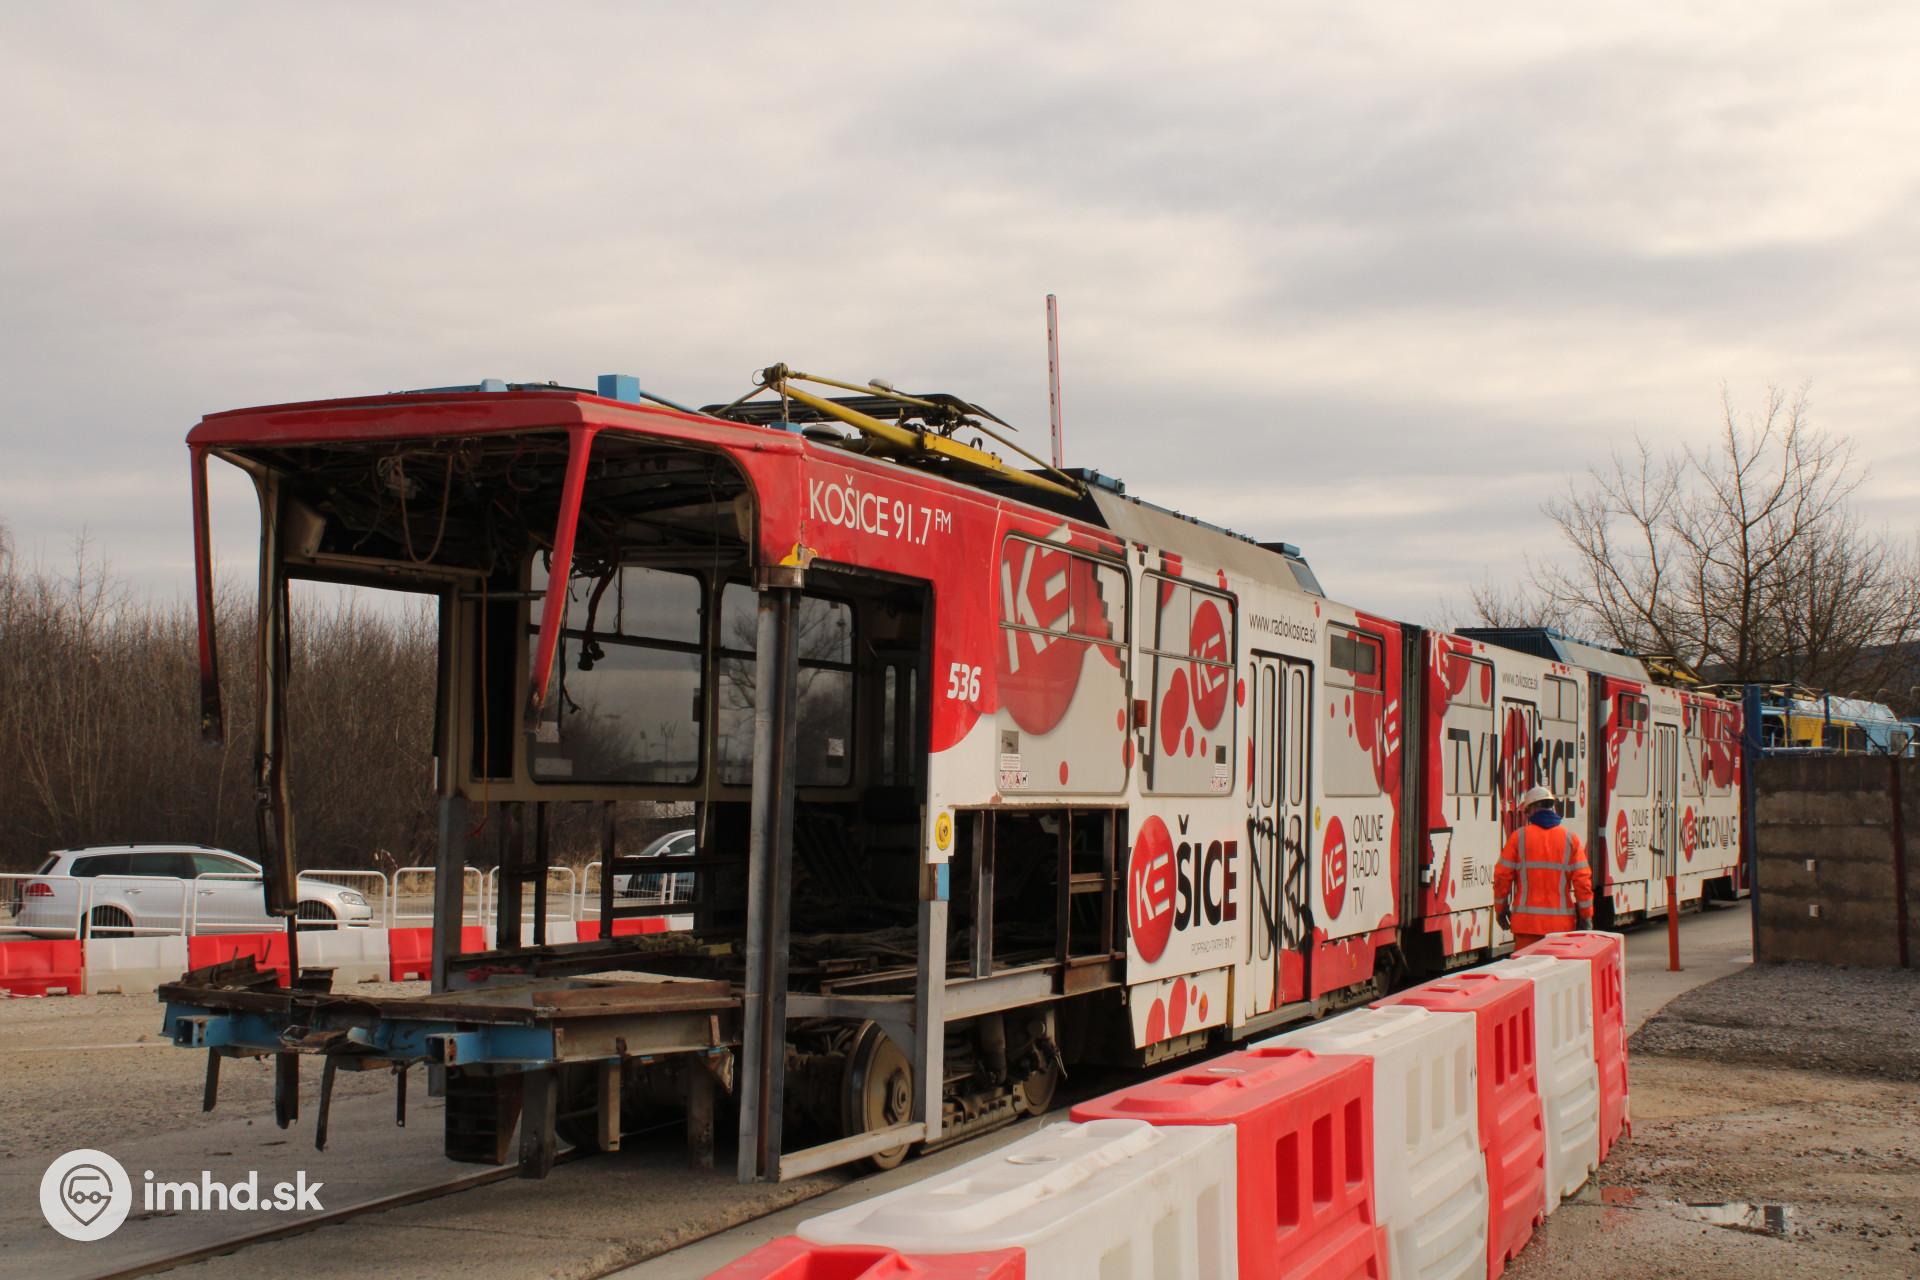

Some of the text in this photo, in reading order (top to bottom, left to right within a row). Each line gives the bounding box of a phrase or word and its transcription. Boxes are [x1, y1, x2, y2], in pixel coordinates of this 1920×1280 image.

[809, 474, 952, 545] KOŠICE 91.7 FM
[1248, 612, 1317, 645] www.radiokosice.sk
[946, 662, 982, 702] 536
[1193, 633, 1225, 701] KE
[1448, 727, 1485, 821] TV
[1353, 814, 1384, 844] ONLINE
[1325, 842, 1345, 895] KE
[1353, 885, 1365, 916] TV
